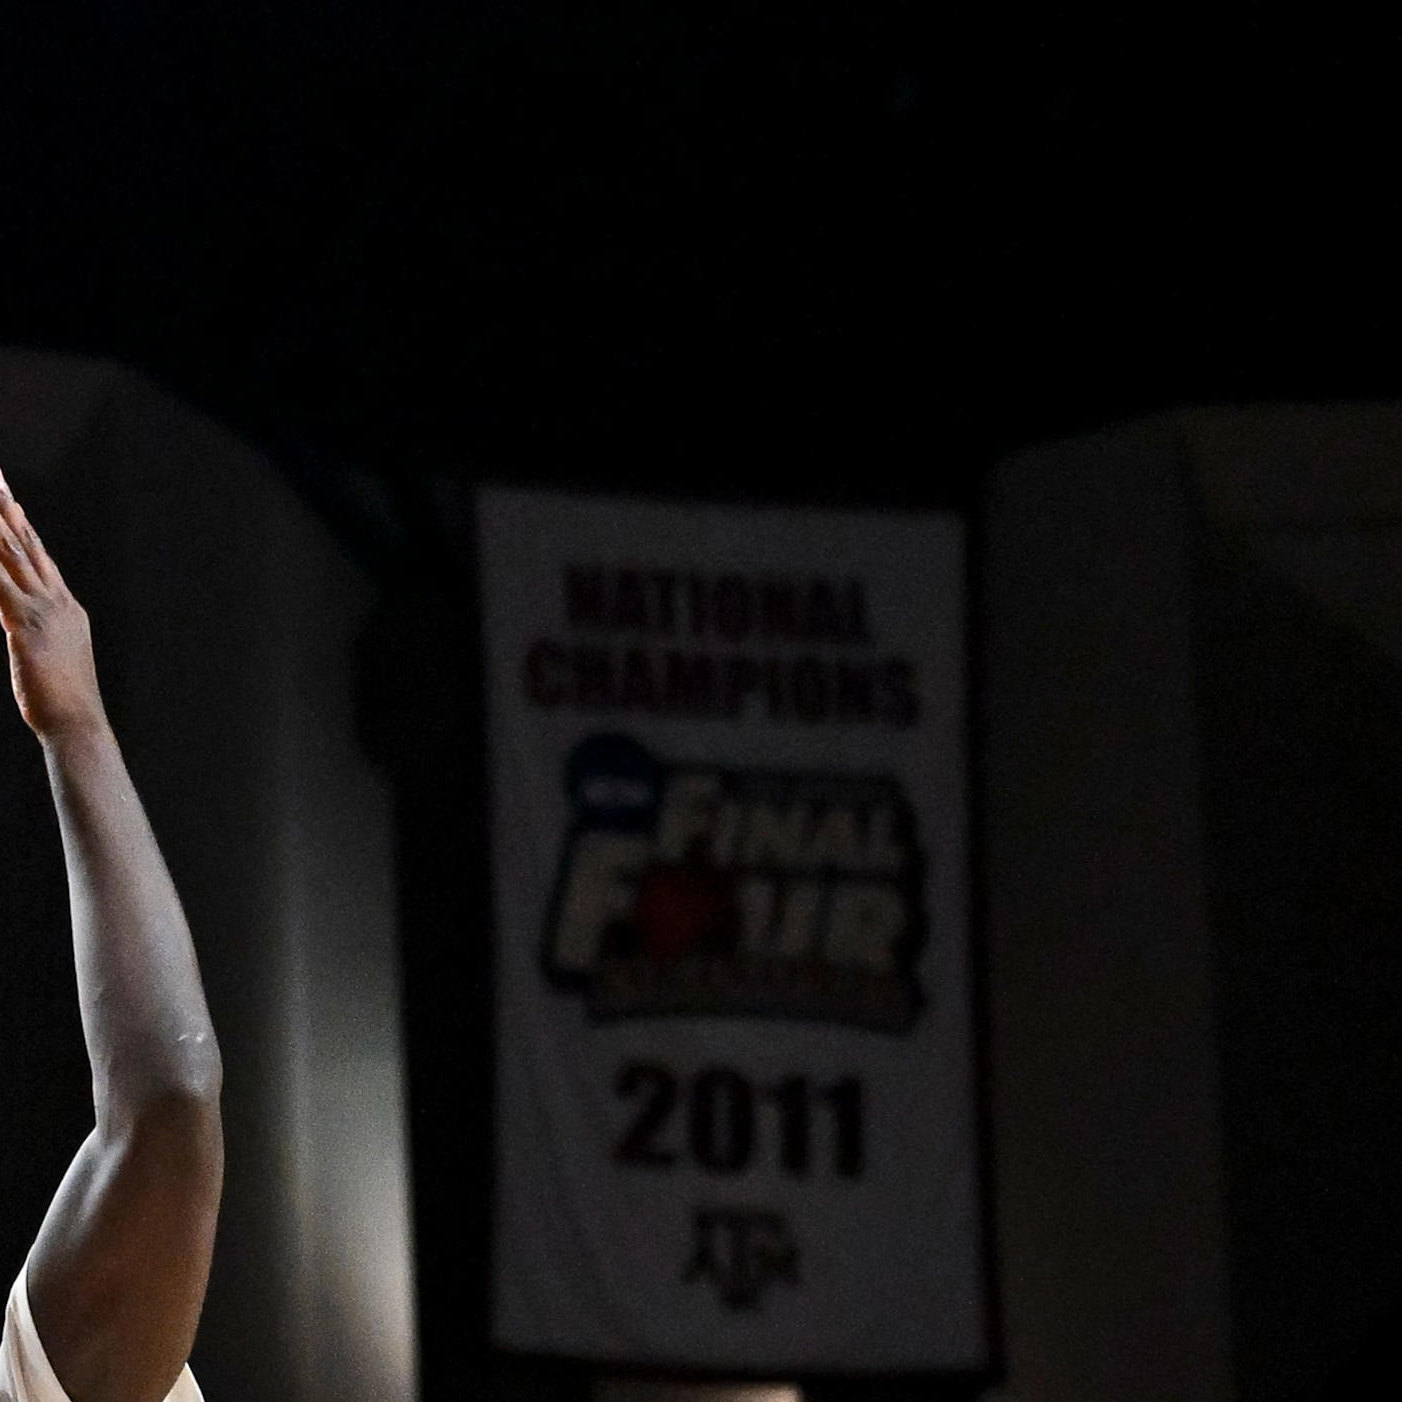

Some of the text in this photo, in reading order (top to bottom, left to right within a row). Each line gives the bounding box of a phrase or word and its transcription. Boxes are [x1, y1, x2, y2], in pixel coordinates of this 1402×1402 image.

[566, 565, 866, 641] NATIONAL
[527, 638, 916, 727] CHAMPIONS
[613, 1062, 864, 1175] 2011
